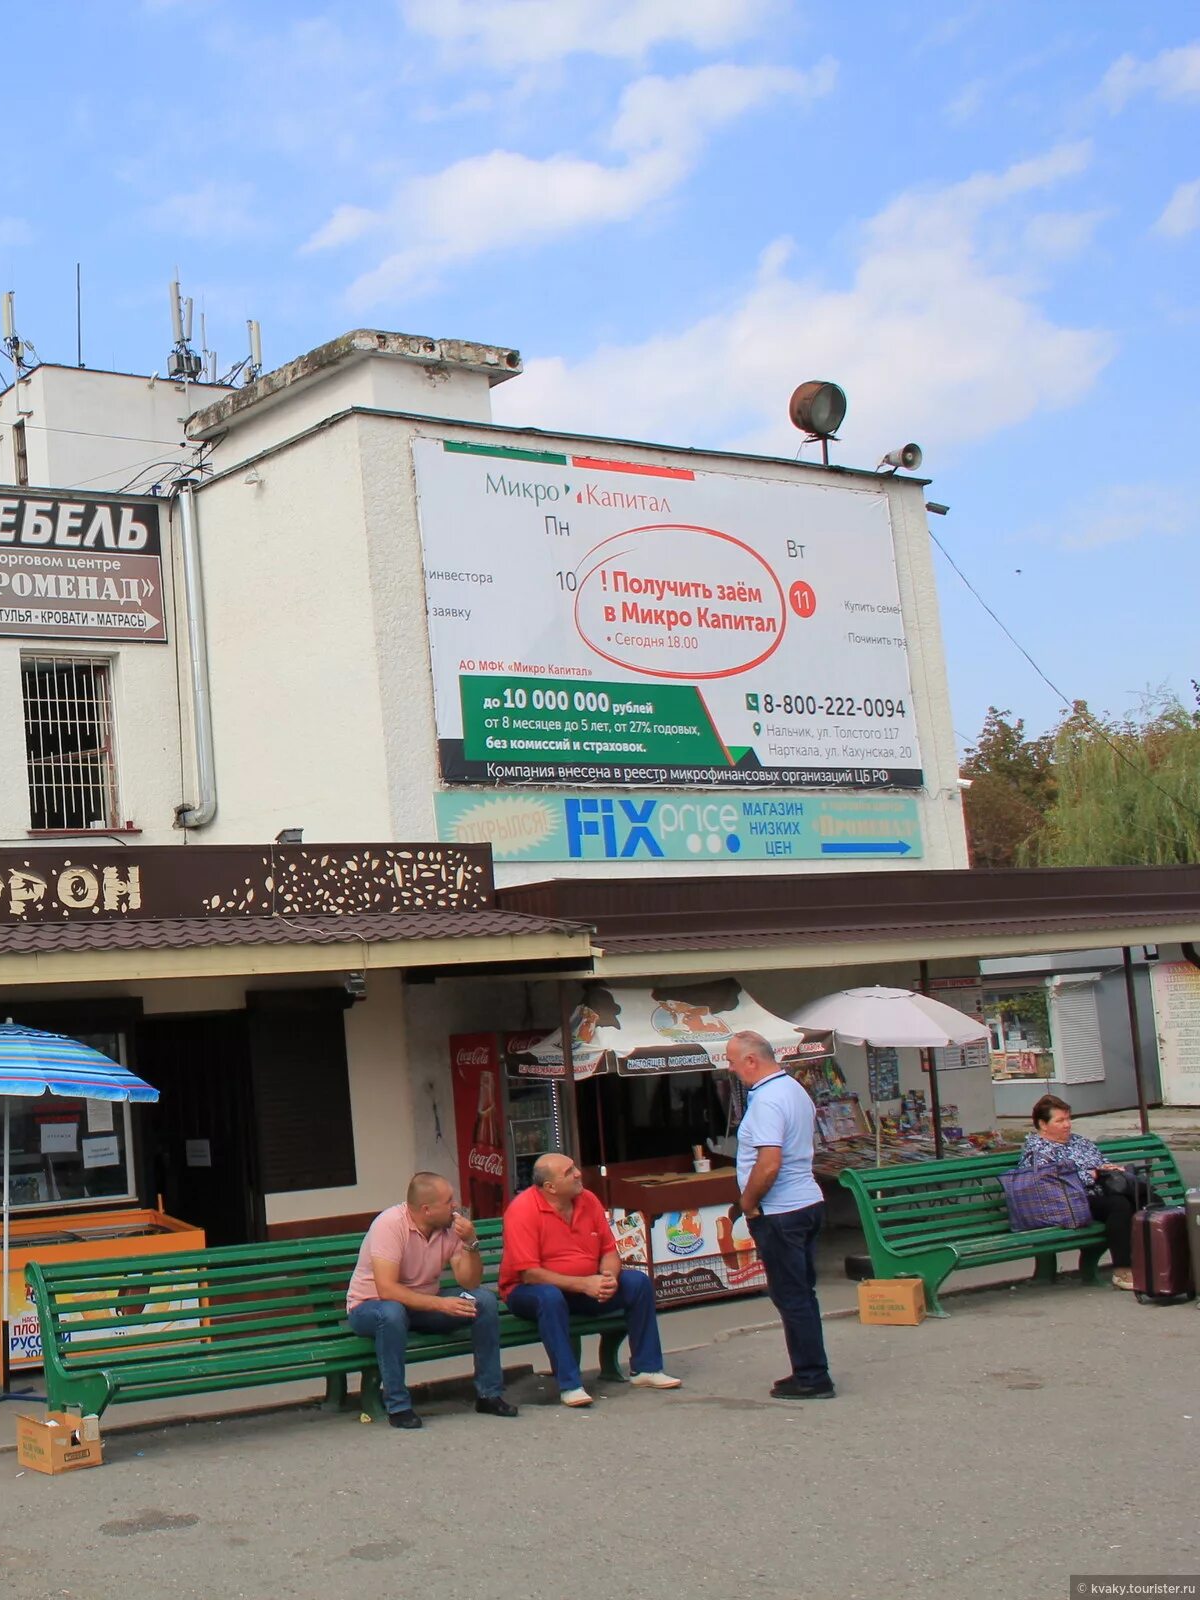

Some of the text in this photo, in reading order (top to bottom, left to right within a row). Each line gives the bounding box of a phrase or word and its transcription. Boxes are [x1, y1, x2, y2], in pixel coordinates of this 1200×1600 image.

[486, 473, 671, 513] Микро Капитал
[544, 516, 570, 536] Пн
[786, 540, 805, 559] Вт
[67, 557, 121, 572] центре
[429, 571, 493, 585] инвестора
[556, 571, 577, 592] 10
[612, 571, 712, 601] Получить
[717, 581, 762, 603] заём
[793, 590, 810, 610] 11
[844, 600, 875, 614] Купить
[40, 611, 89, 625] КРОВАТИ
[96, 613, 147, 627] МАТРАСЫ
[432, 607, 471, 621] заявку
[604, 602, 777, 633] в Микро Капитал
[615, 632, 698, 649] Сегодня 18.00
[848, 632, 891, 646] Починить
[459, 660, 475, 671] АО
[479, 660, 504, 671] МФК
[483, 688, 653, 716] до 10 000 000 рублей
[763, 694, 906, 718] 8-800-222-0094
[484, 716, 700, 736] от 8 месяцев до 5 лет, от 27% годовых,
[766, 725, 899, 740] Нальчик, ул. Толстого 117
[486, 736, 647, 754] без комиссий и страховок.
[827, 745, 839, 759] ул.
[899, 746, 912, 759] 20
[486, 762, 888, 784] Компания внесена в реестр микрофинансовых организаций ЦБ РФ
[742, 802, 804, 816] МАГАЗИН
[659, 803, 738, 840] price
[749, 822, 801, 835] НИЗКИХ
[765, 841, 792, 857] ЦЕН
[457, 1047, 490, 1066] Coca-Cola
[468, 1147, 504, 1176] Coca-Cola
